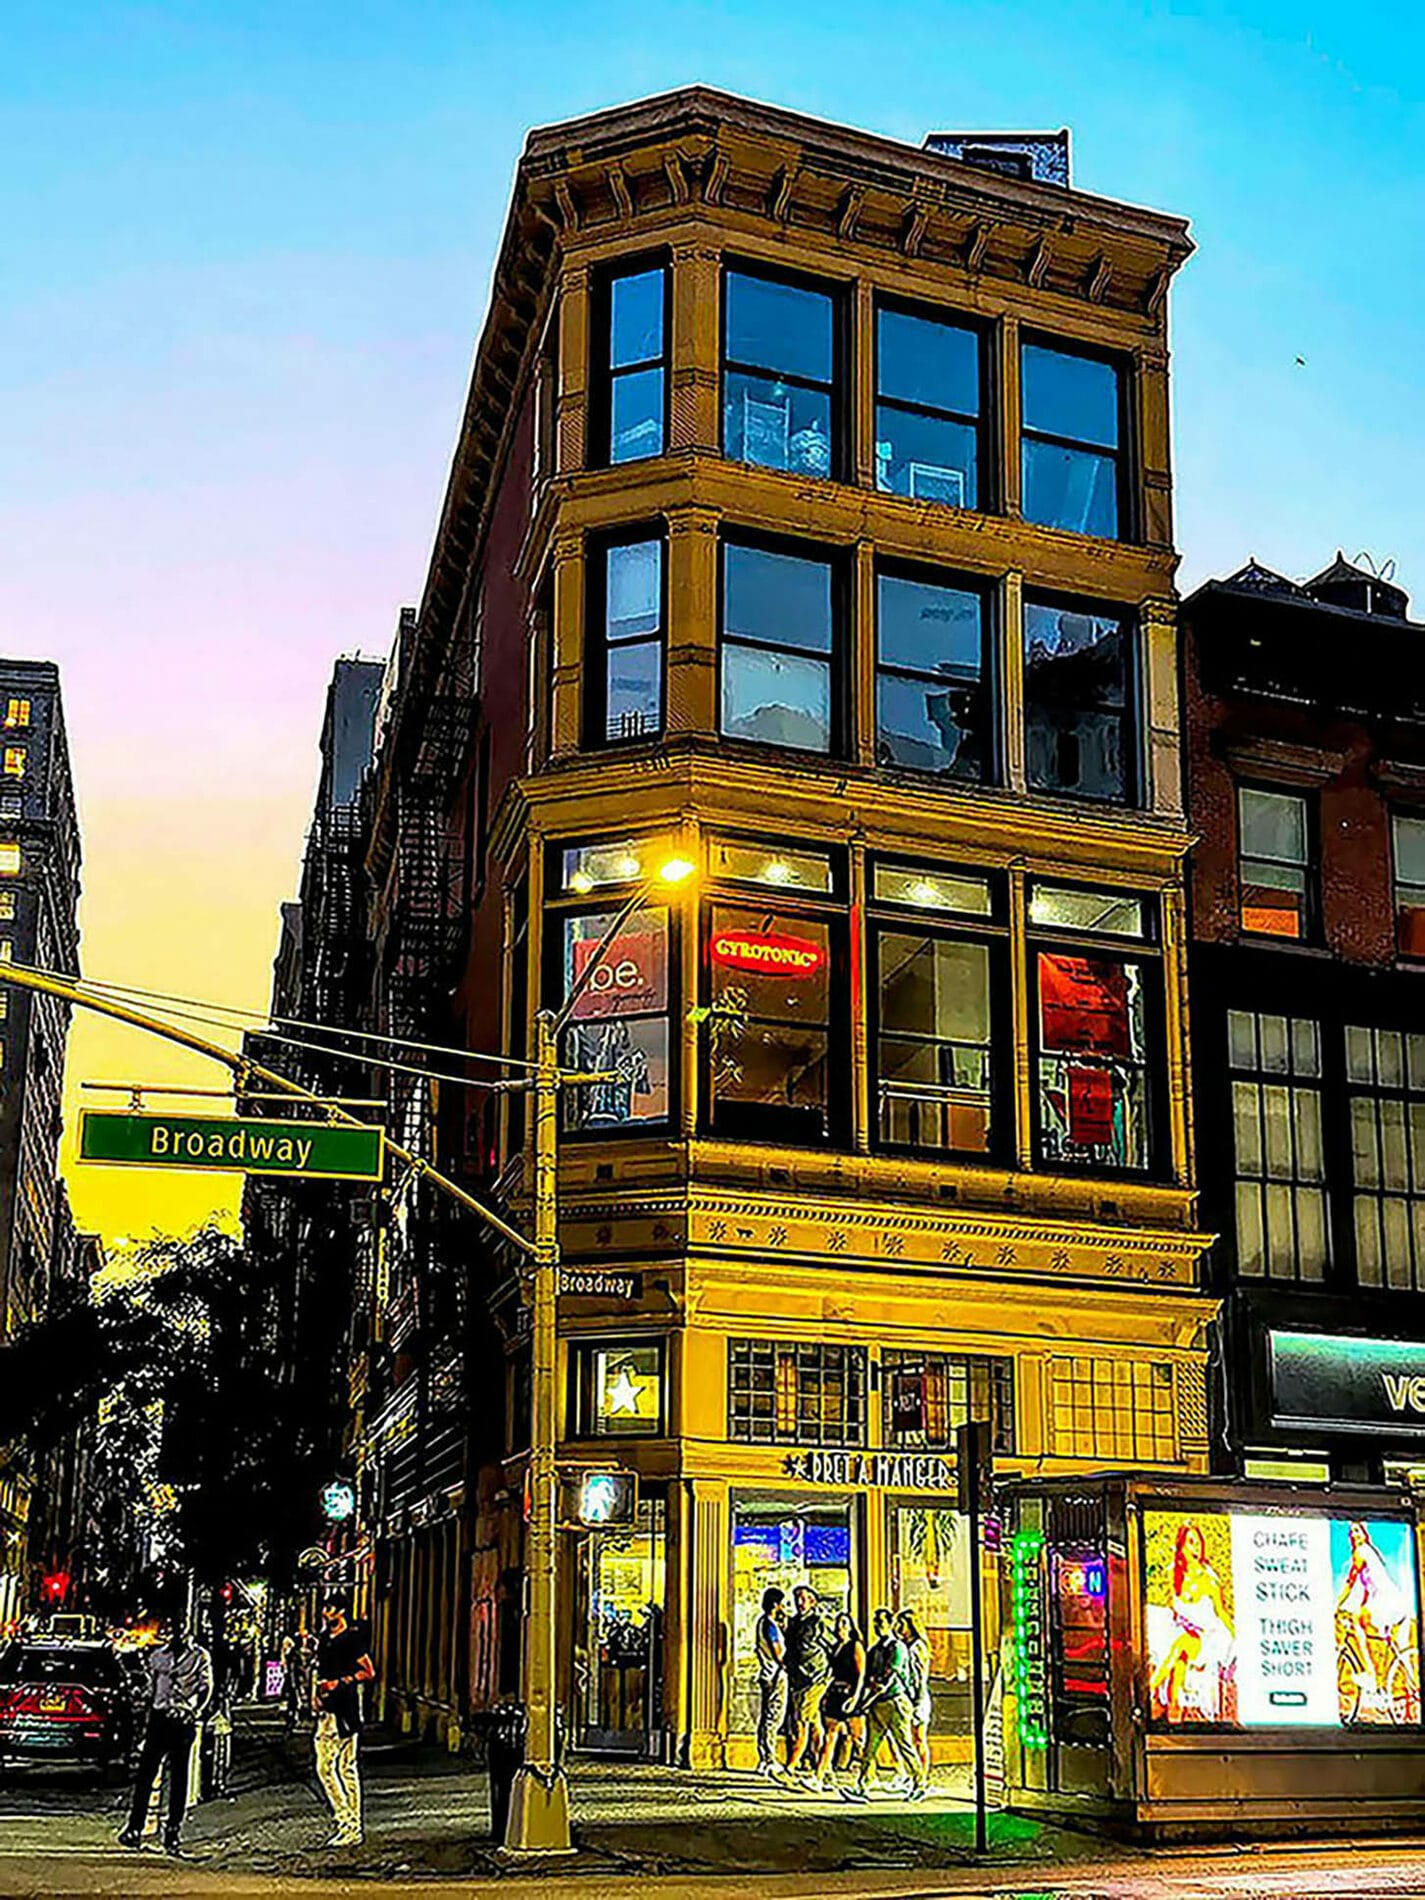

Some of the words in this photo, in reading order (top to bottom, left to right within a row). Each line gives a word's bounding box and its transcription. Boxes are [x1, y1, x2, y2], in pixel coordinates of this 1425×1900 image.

[151, 1126, 312, 1168] Broadway
[560, 1274, 635, 1299] Broadway
[813, 1454, 850, 1483] PRET
[877, 1456, 949, 1489] MANGER
[1253, 1531, 1309, 1550] CHAFE
[1254, 1556, 1308, 1574] SWEAT
[1255, 1581, 1311, 1602] STICK
[1259, 1617, 1314, 1636] THIGH
[1260, 1640, 1314, 1657] SAVER
[1261, 1659, 1314, 1677] SHORT
